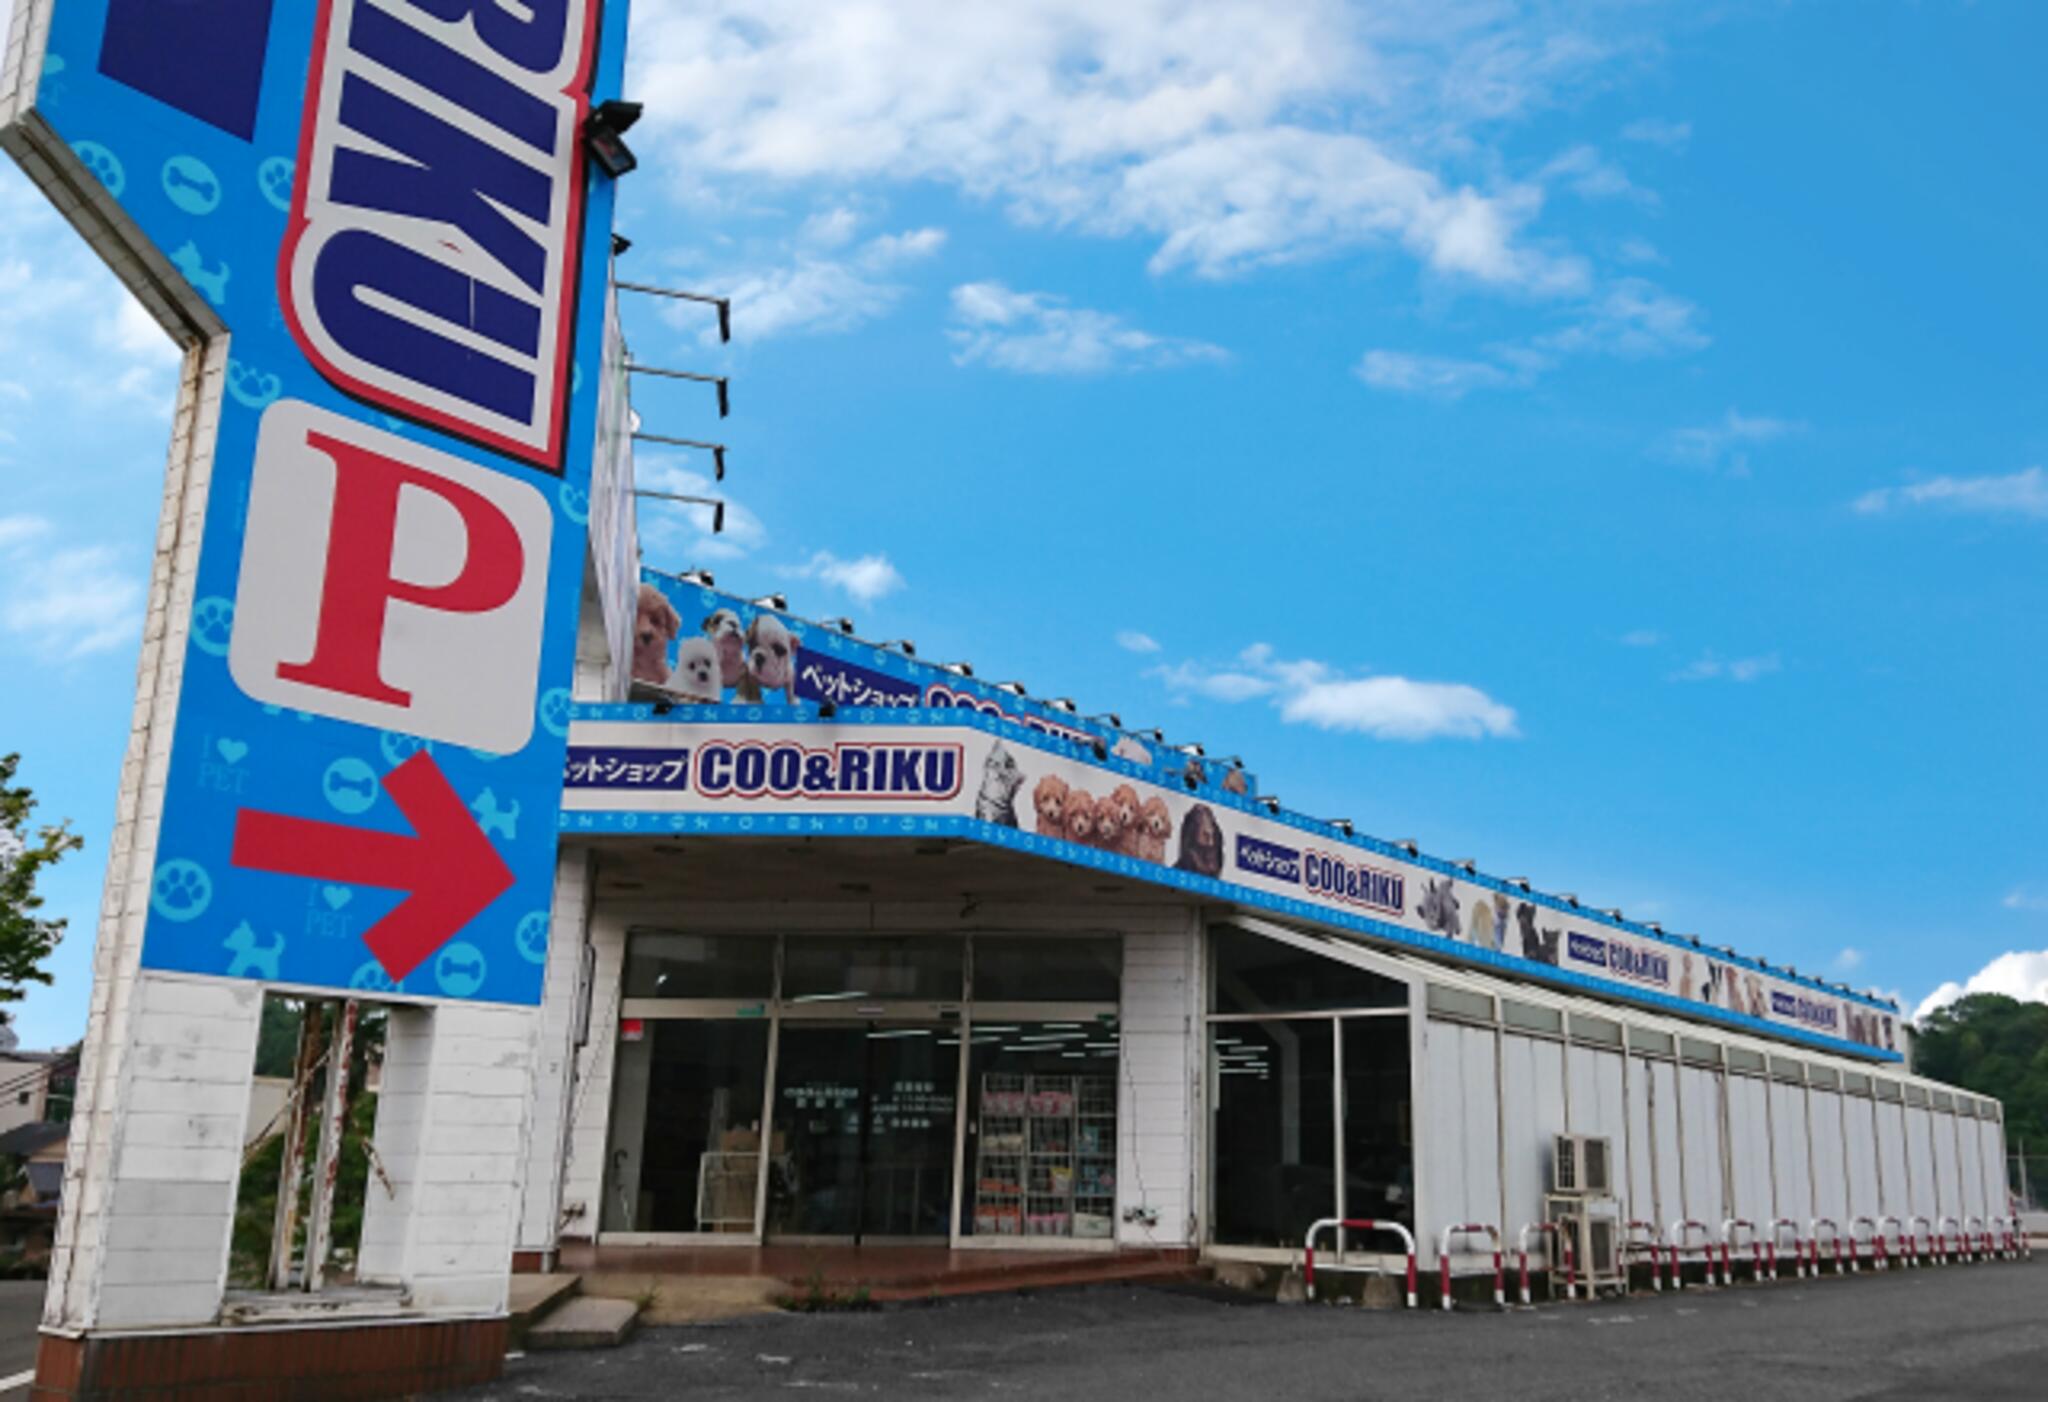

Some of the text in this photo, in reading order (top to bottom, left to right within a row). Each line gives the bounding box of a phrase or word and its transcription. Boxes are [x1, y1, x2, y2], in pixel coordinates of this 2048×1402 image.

[276, 429, 524, 708] P
[699, 745, 956, 794] COO&RIKU
[1305, 852, 1404, 911] COO&RIKU
